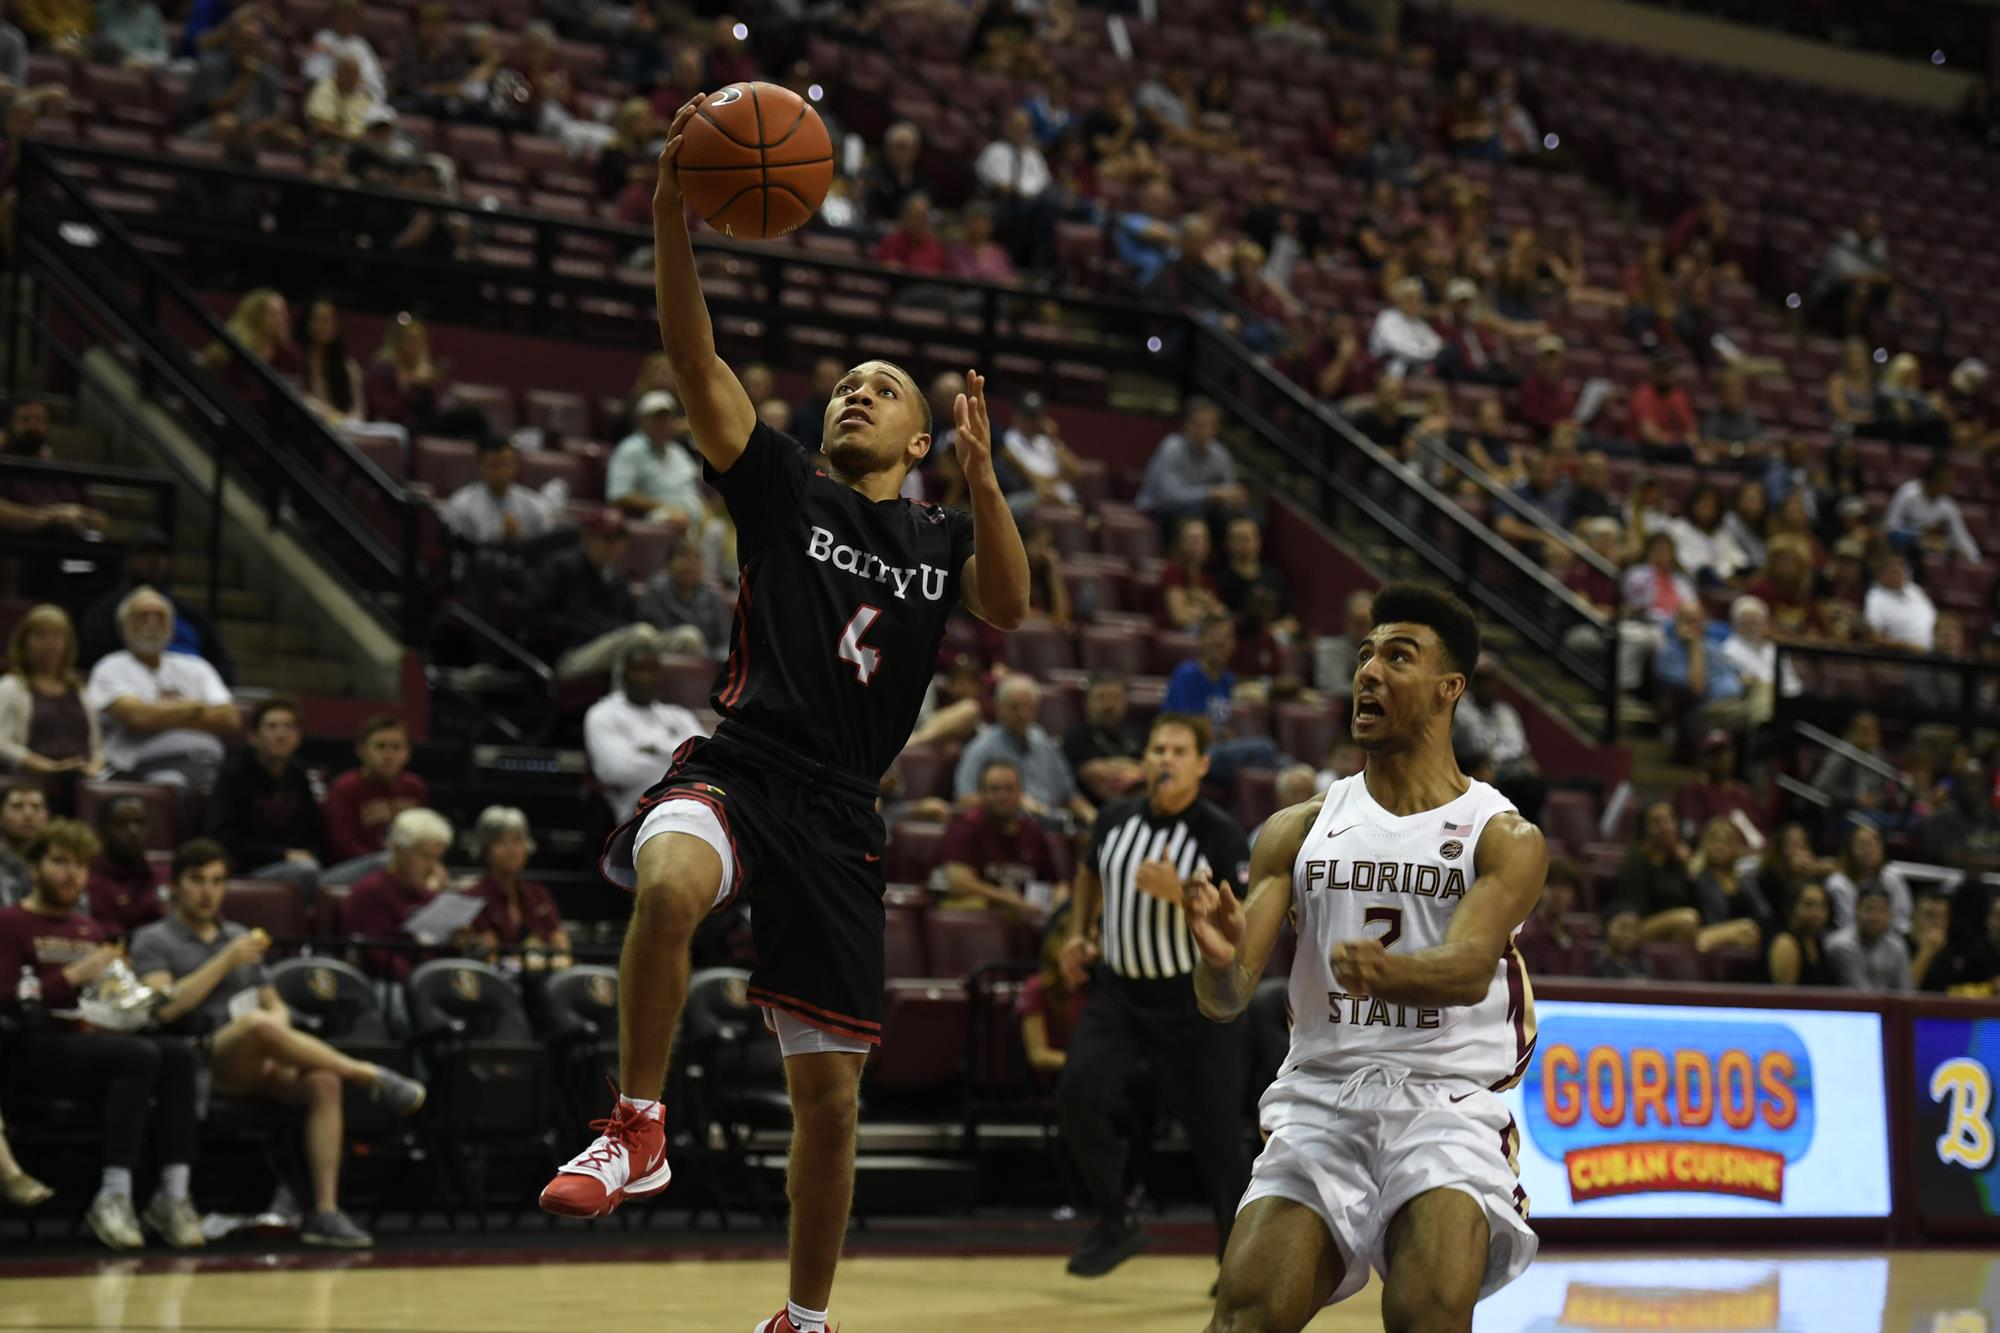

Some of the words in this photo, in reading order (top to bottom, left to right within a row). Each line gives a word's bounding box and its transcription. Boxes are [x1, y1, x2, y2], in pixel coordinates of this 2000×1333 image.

[838, 603, 882, 686] 4
[1305, 860, 1465, 900] FLORIDA
[1541, 1043, 1799, 1130] GORDOS
[1930, 1056, 1997, 1170] B
[1573, 1150, 1668, 1190] CUBAN
[1673, 1148, 1781, 1192] CUISINE
